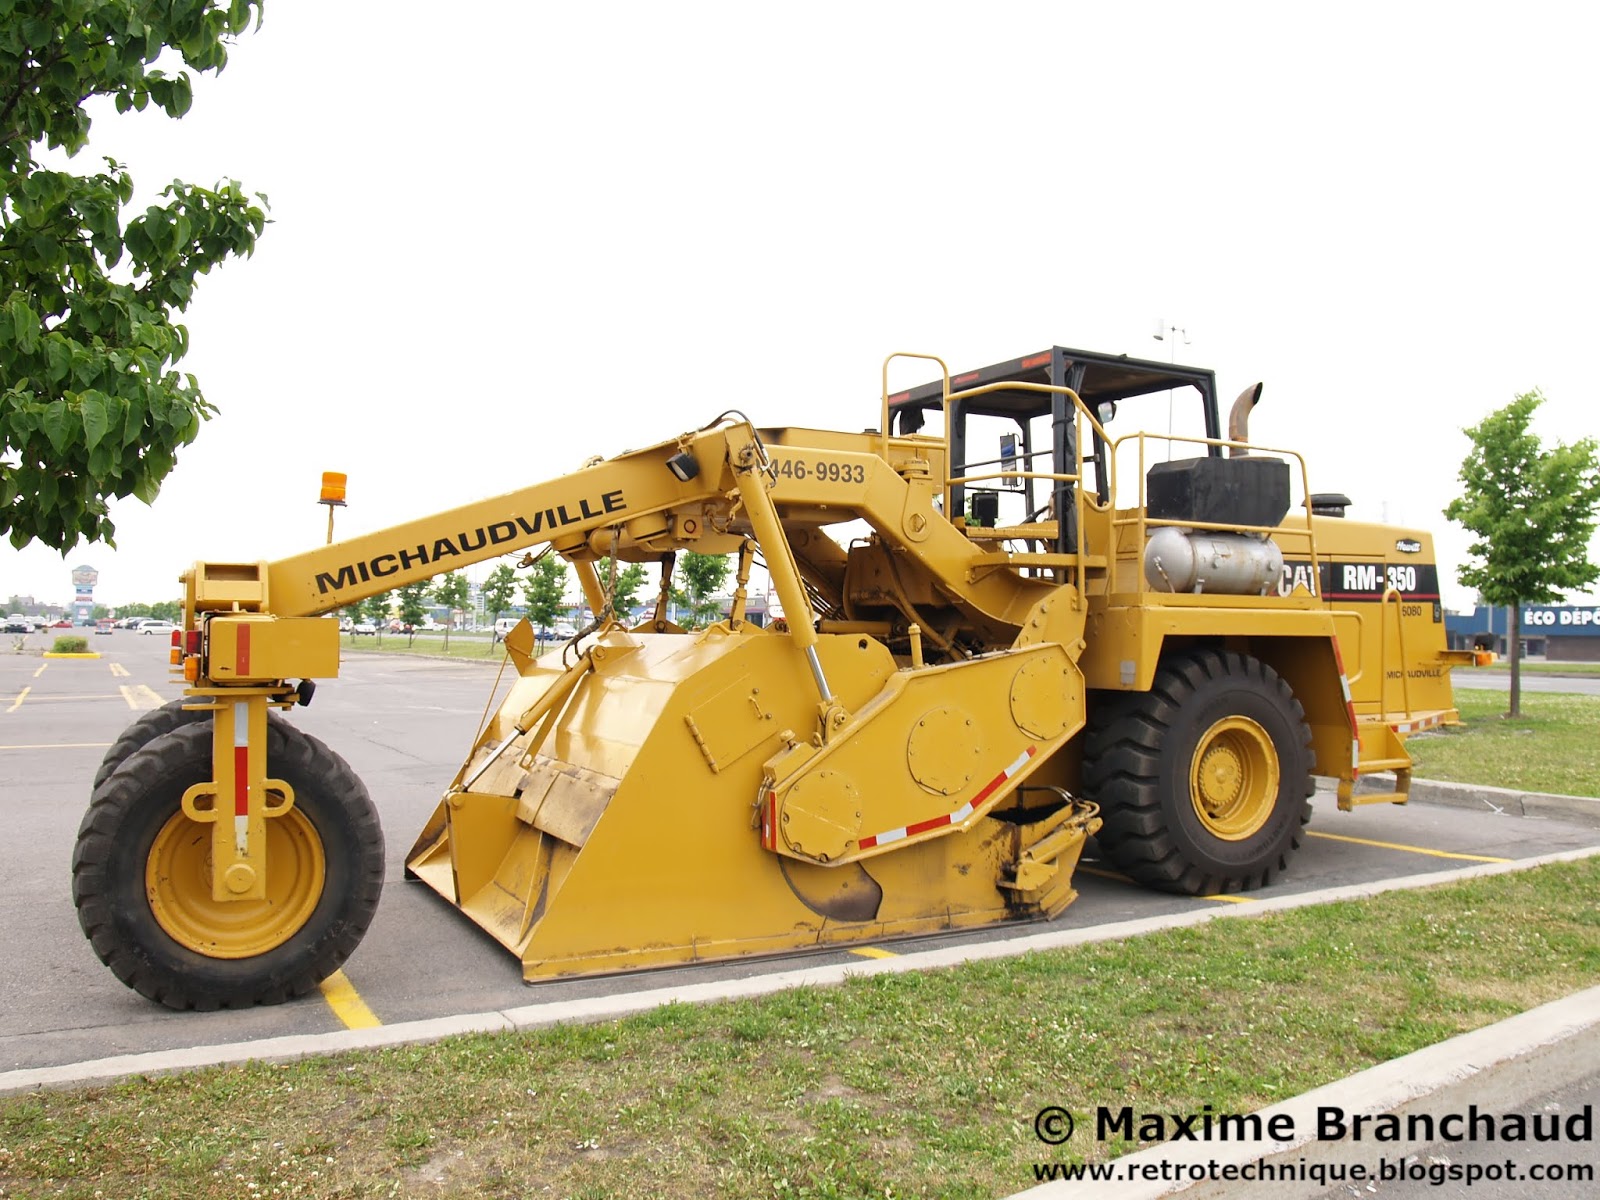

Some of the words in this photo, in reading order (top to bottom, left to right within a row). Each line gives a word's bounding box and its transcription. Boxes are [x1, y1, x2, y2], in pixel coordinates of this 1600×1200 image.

[315, 490, 628, 595] MICHAUDVILLE
[1277, 564, 1321, 598] CAT
[1524, 607, 1556, 626] ÉCO
